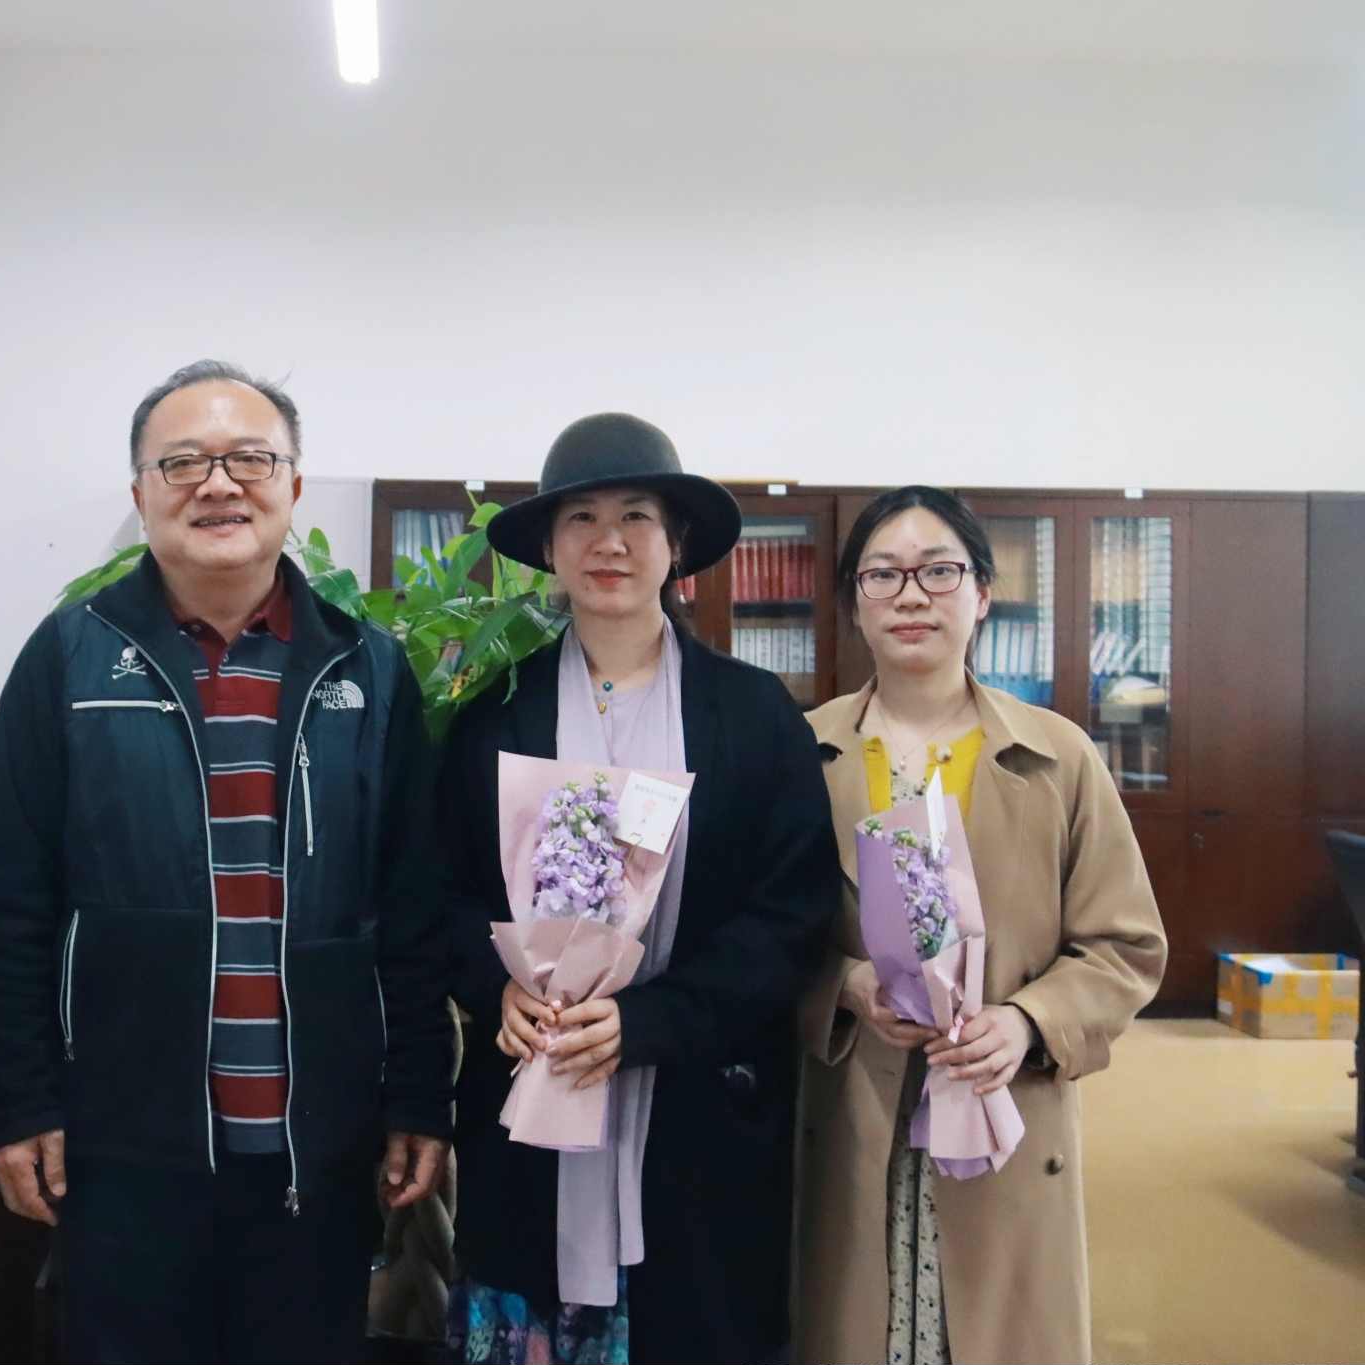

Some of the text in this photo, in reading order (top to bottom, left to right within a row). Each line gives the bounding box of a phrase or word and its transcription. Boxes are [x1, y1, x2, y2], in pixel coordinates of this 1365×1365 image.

[321, 681, 343, 690] THE
[310, 689, 345, 701] NORTH
[322, 699, 348, 709] FACE
